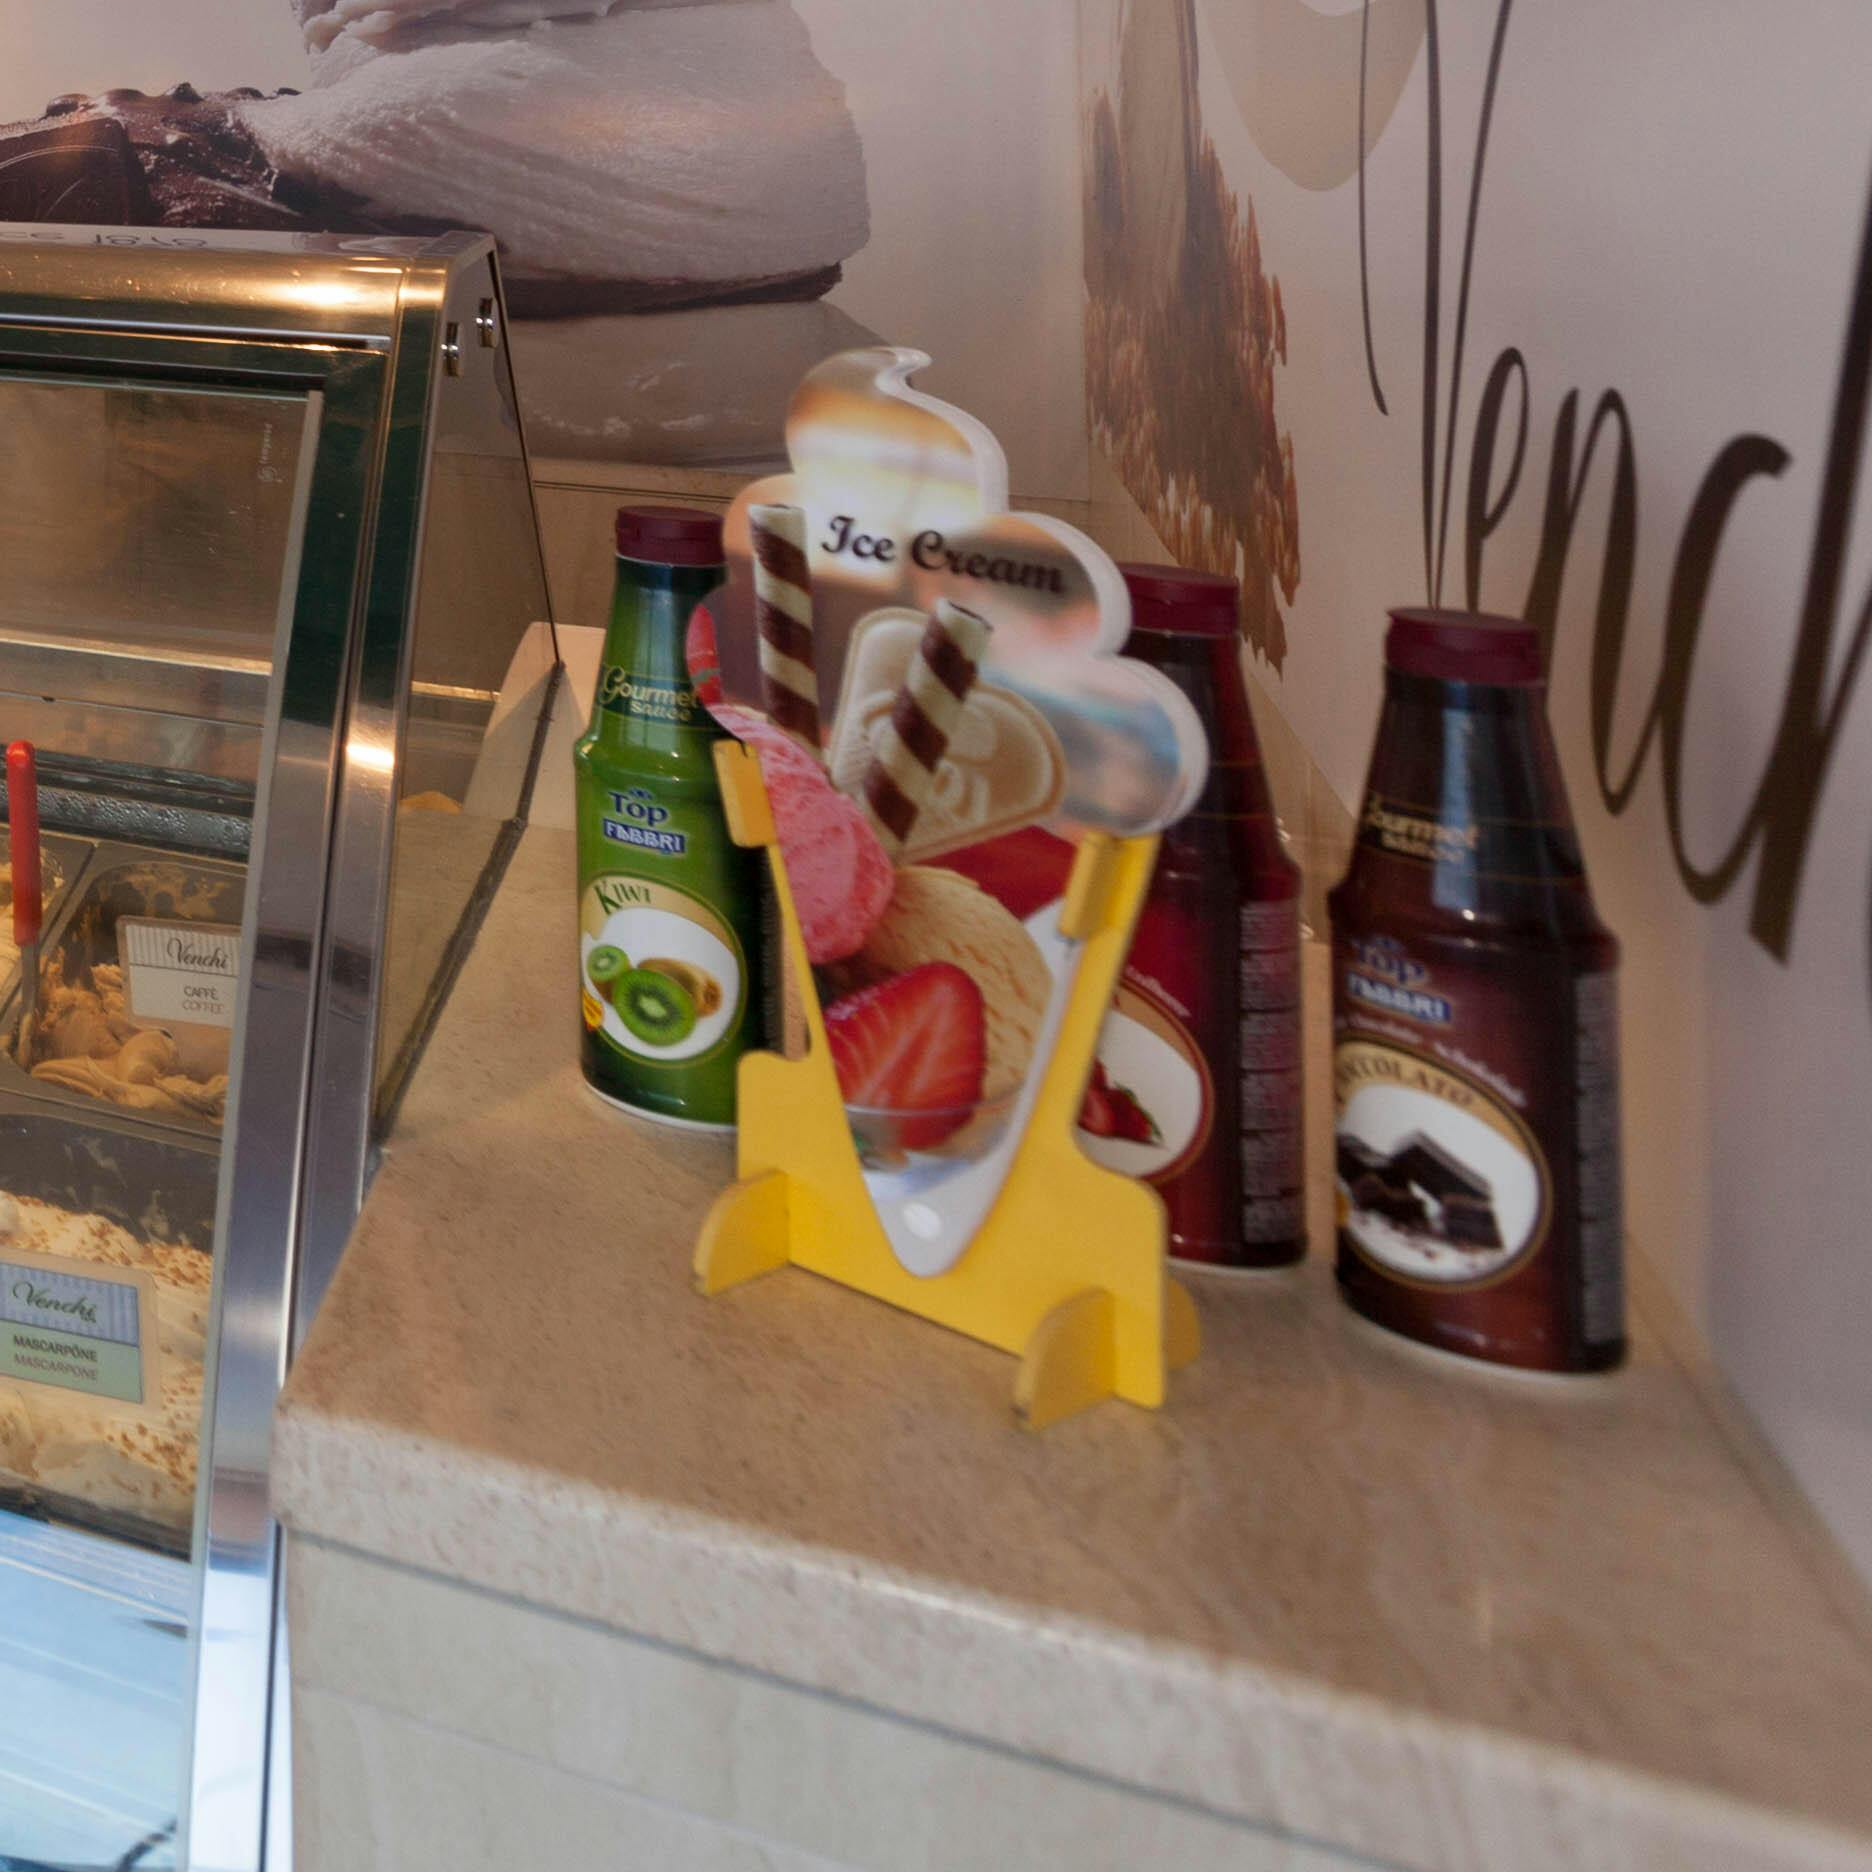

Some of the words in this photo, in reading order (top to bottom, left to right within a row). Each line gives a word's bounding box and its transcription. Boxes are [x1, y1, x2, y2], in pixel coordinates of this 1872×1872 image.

[821, 515, 895, 561] Ice
[909, 530, 1067, 598] Cream
[607, 790, 669, 827] Top
[606, 822, 683, 852] FABBRI
[166, 937, 230, 969] Venchi
[12, 1280, 96, 1321] Venchi
[13, 1354, 98, 1381] MASCARPONE
